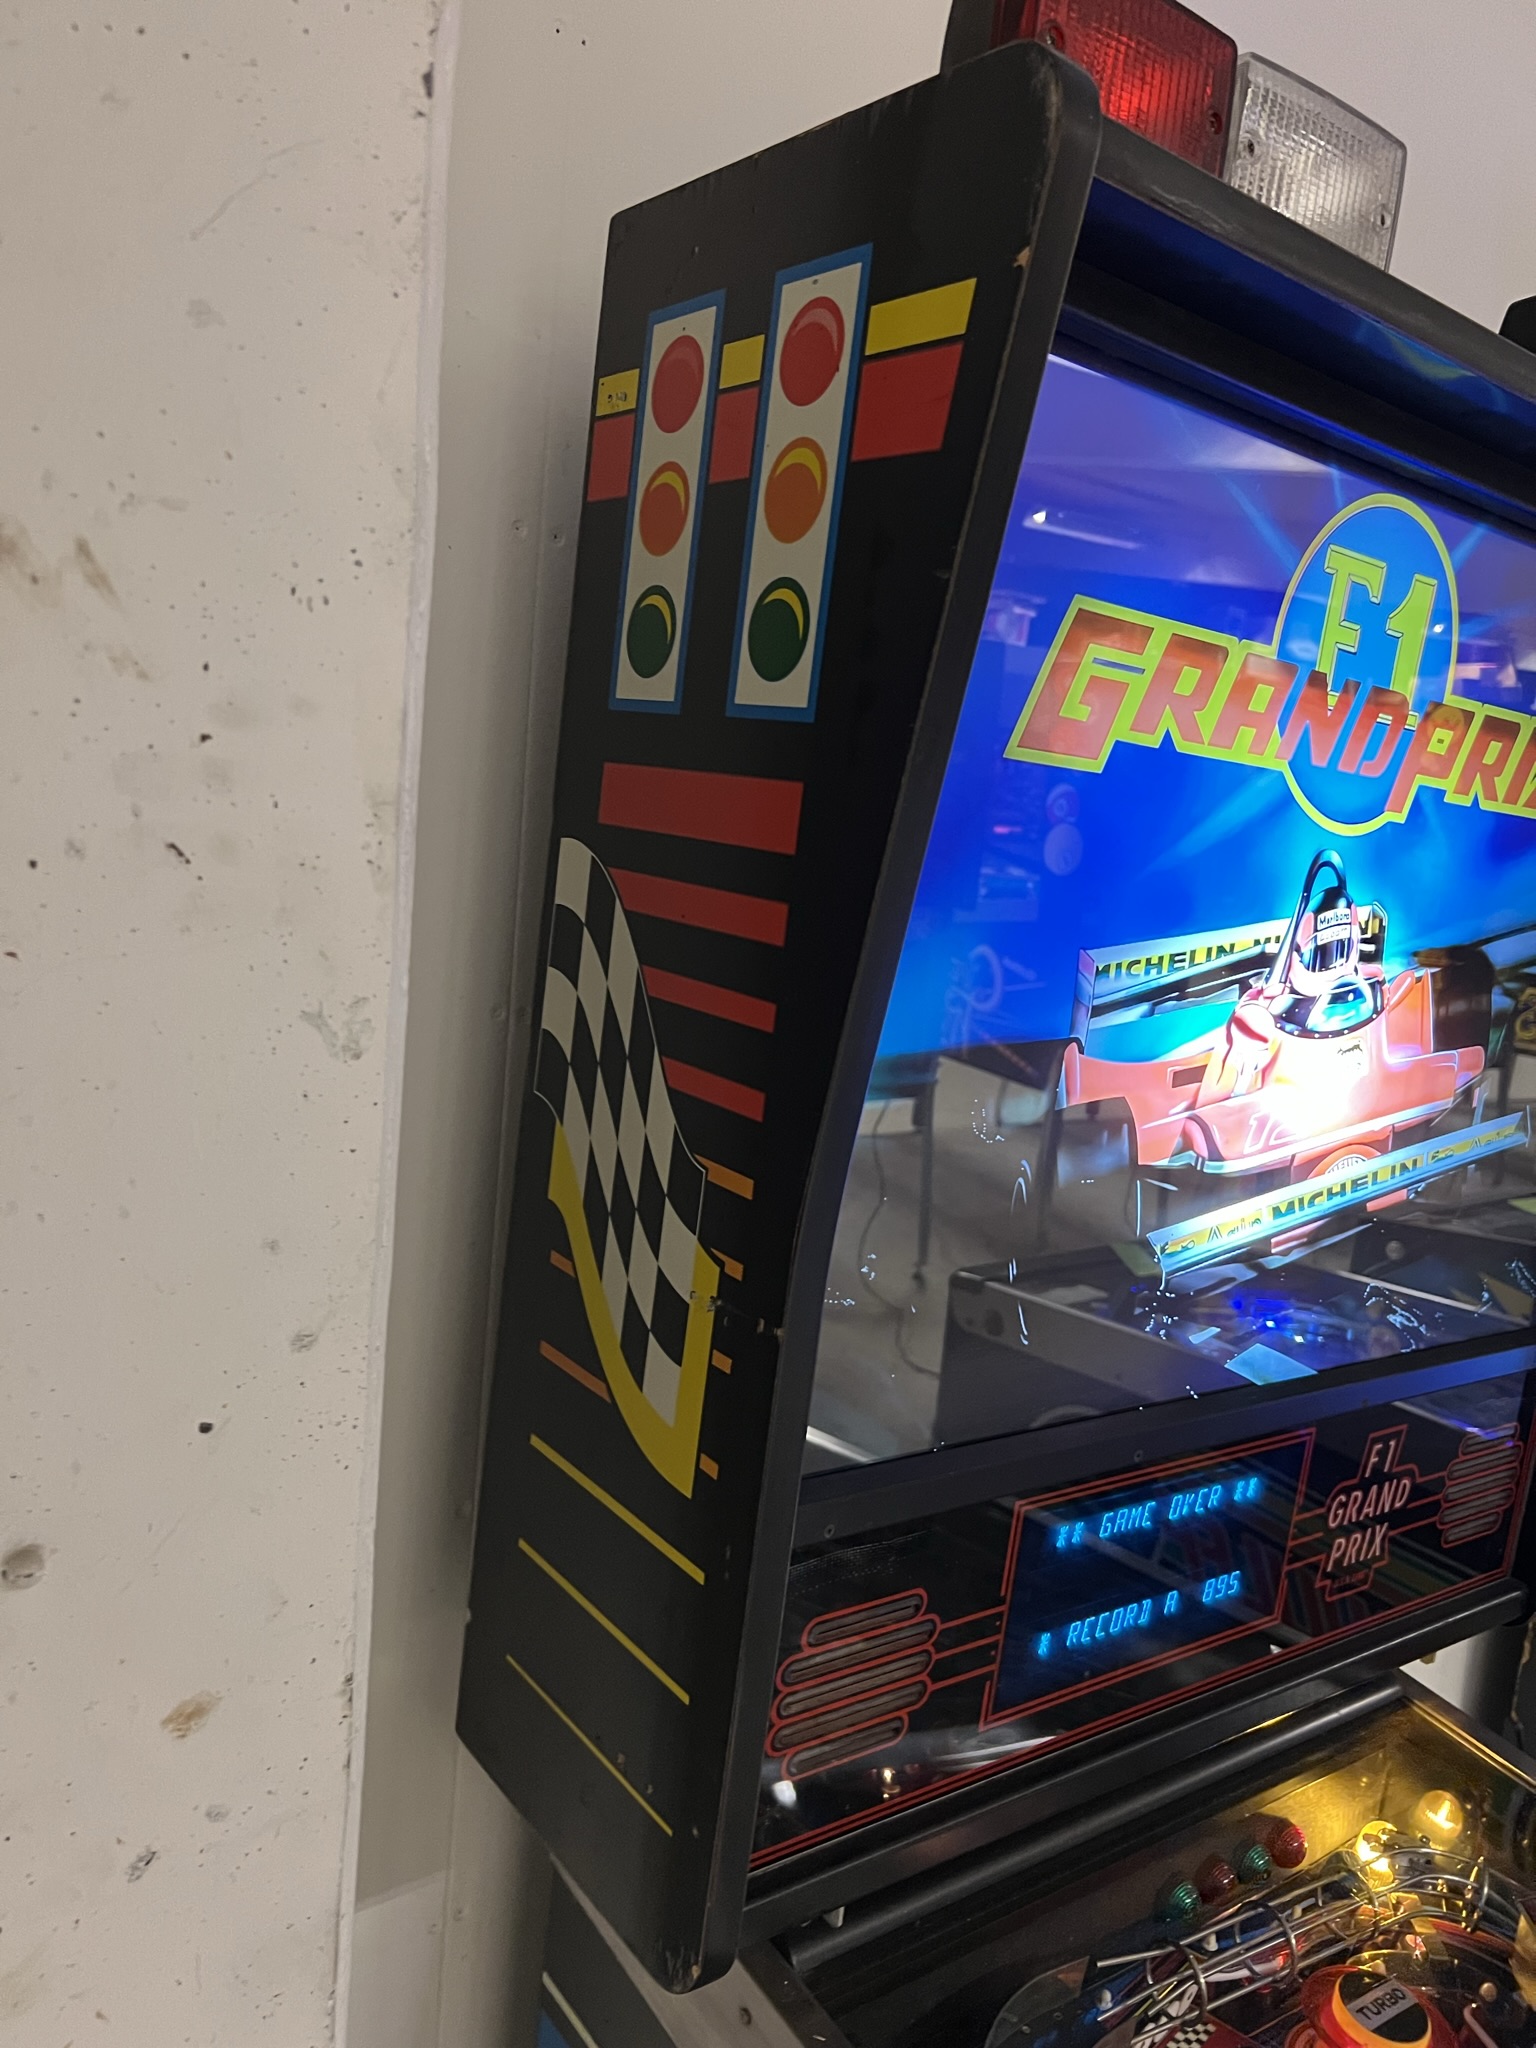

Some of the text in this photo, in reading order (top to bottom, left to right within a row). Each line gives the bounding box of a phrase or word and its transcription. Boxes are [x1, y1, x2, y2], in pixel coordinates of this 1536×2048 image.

[1316, 543, 1438, 731] F1
[1013, 604, 1411, 778] GRAND
[1096, 943, 1235, 980] MICHELIN
[1272, 1157, 1419, 1220] MICHELIN
[1364, 1439, 1398, 1478] F1
[1099, 1501, 1157, 1538] GAME
[1168, 1484, 1223, 1521] OVER
[1328, 1478, 1412, 1530] GRAND
[1326, 1521, 1390, 1573] PRIX
[1066, 1599, 1152, 1647] RECORD
[1163, 1590, 1179, 1615] A
[1202, 1570, 1241, 1602] 895
[1355, 1988, 1407, 2021] TURBO
